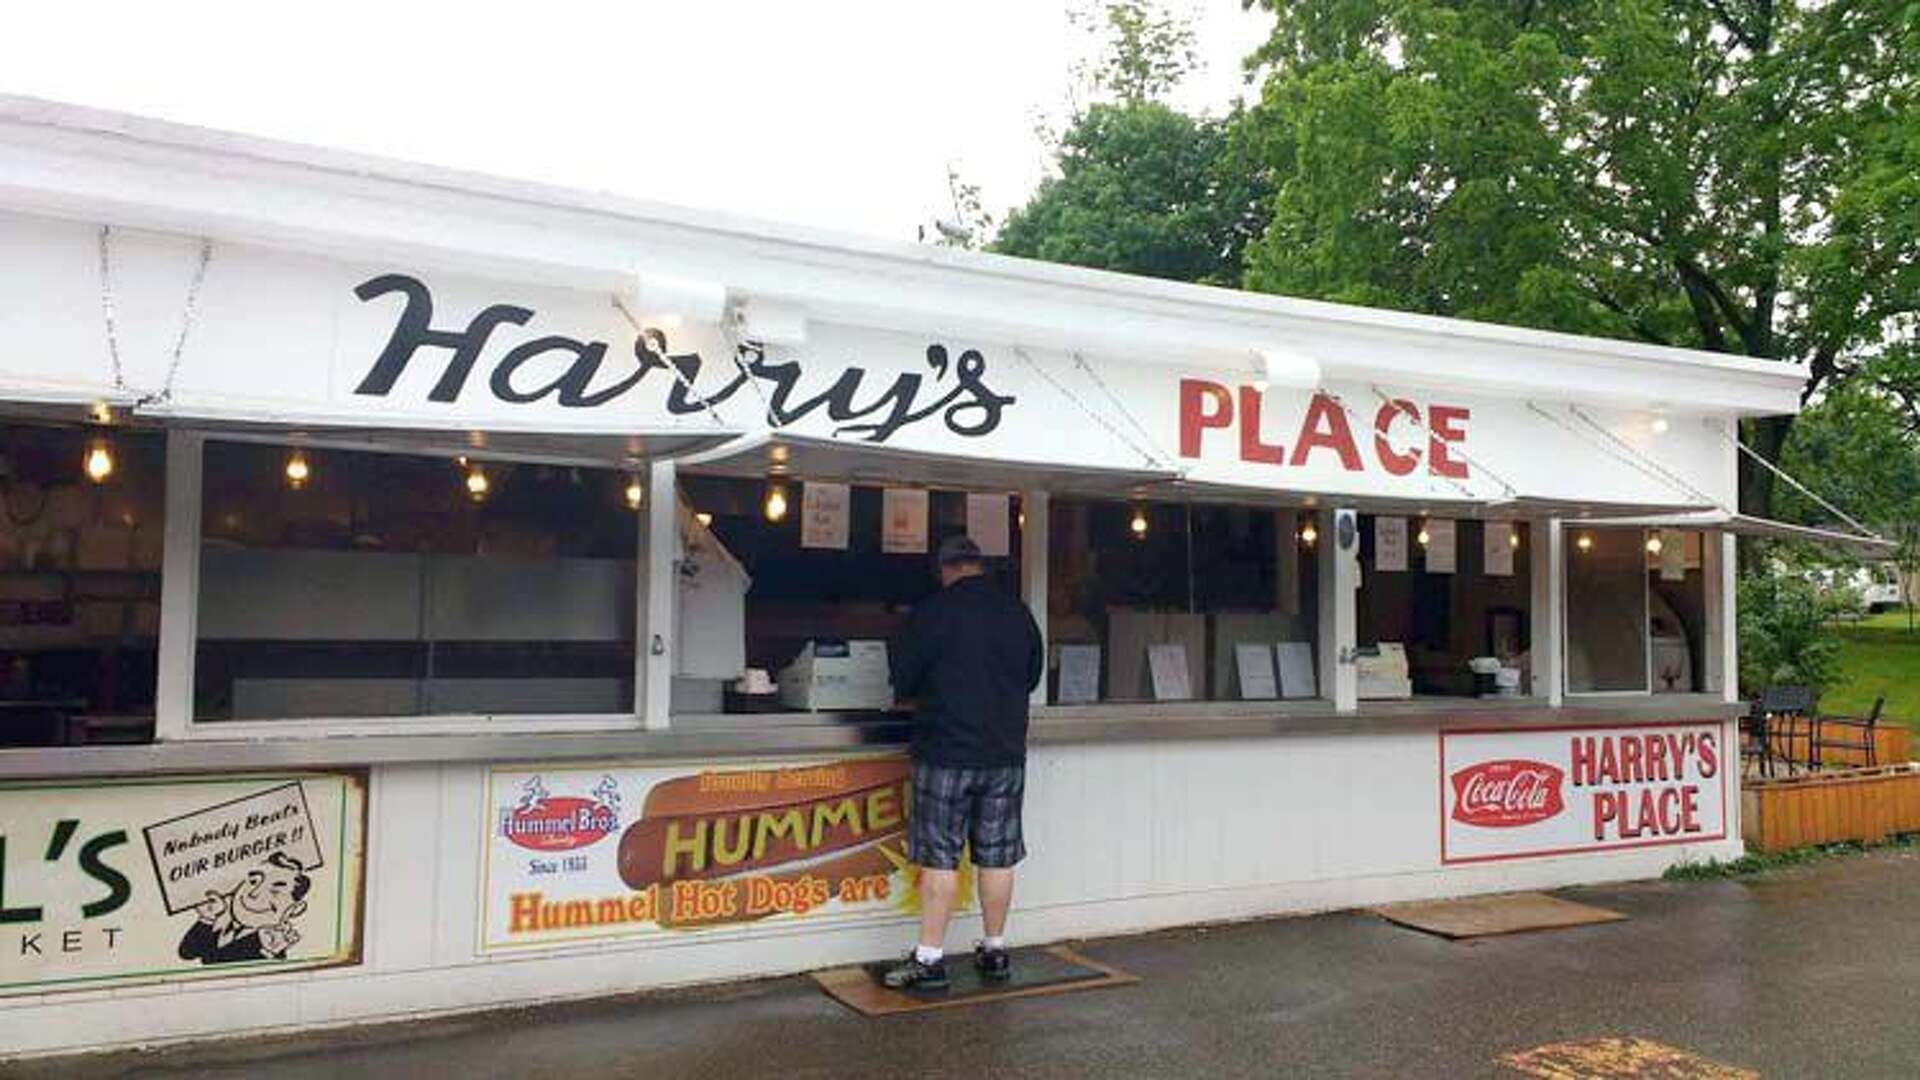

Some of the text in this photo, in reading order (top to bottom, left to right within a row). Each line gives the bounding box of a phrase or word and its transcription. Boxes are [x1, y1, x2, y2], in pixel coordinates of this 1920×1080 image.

[353, 273, 1016, 444] Harry's
[1178, 378, 1471, 480] PLACE
[1570, 732, 1718, 786] HARRY'S
[163, 804, 299, 857] Nobody Beats
[502, 808, 576, 836] Hummel
[1592, 785, 1702, 840] PLACE
[168, 857, 210, 882] OUR
[213, 830, 288, 868] BURGER
[508, 872, 890, 934] Hummel Hot Dogs are
